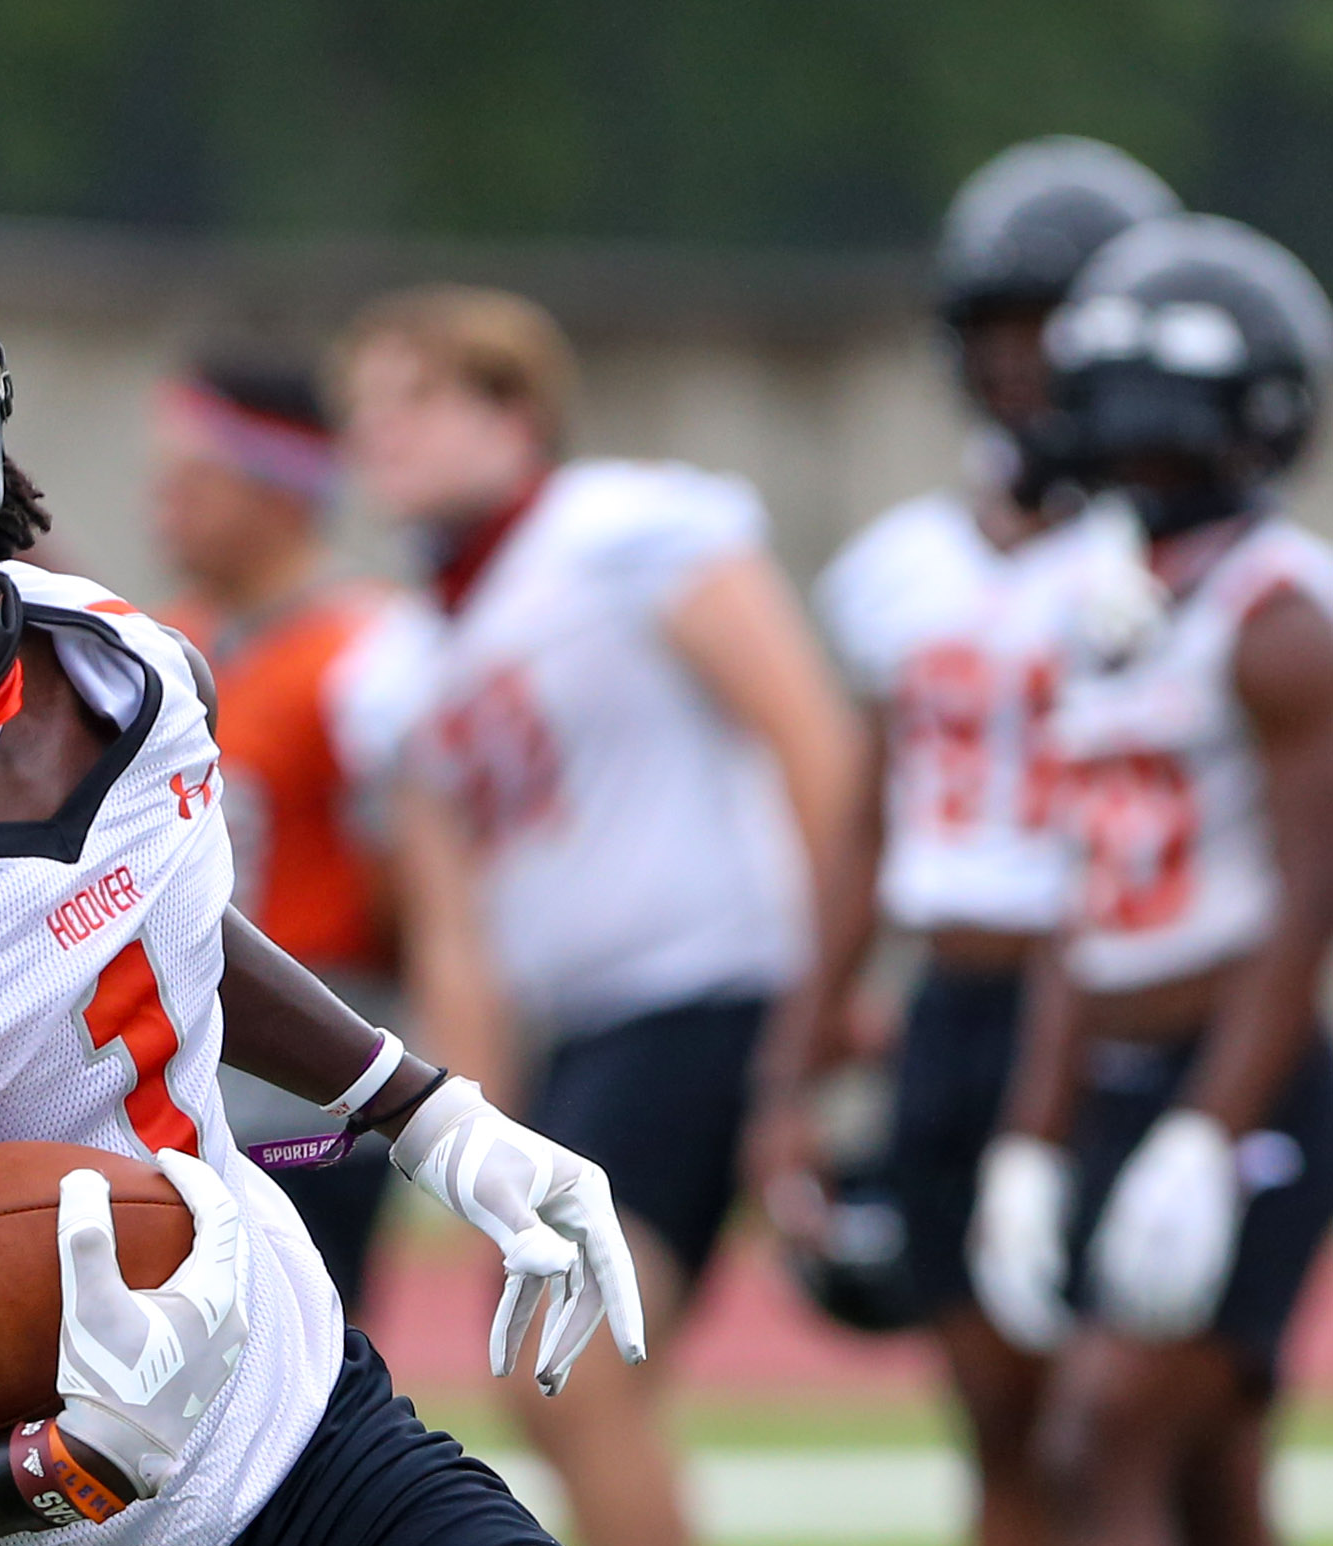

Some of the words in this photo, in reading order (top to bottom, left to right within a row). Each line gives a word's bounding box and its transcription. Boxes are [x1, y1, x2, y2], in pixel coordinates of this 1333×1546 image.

[45, 865, 145, 951] HOOVER
[72, 932, 206, 1163] 1
[262, 1141, 318, 1164] SPORTS
